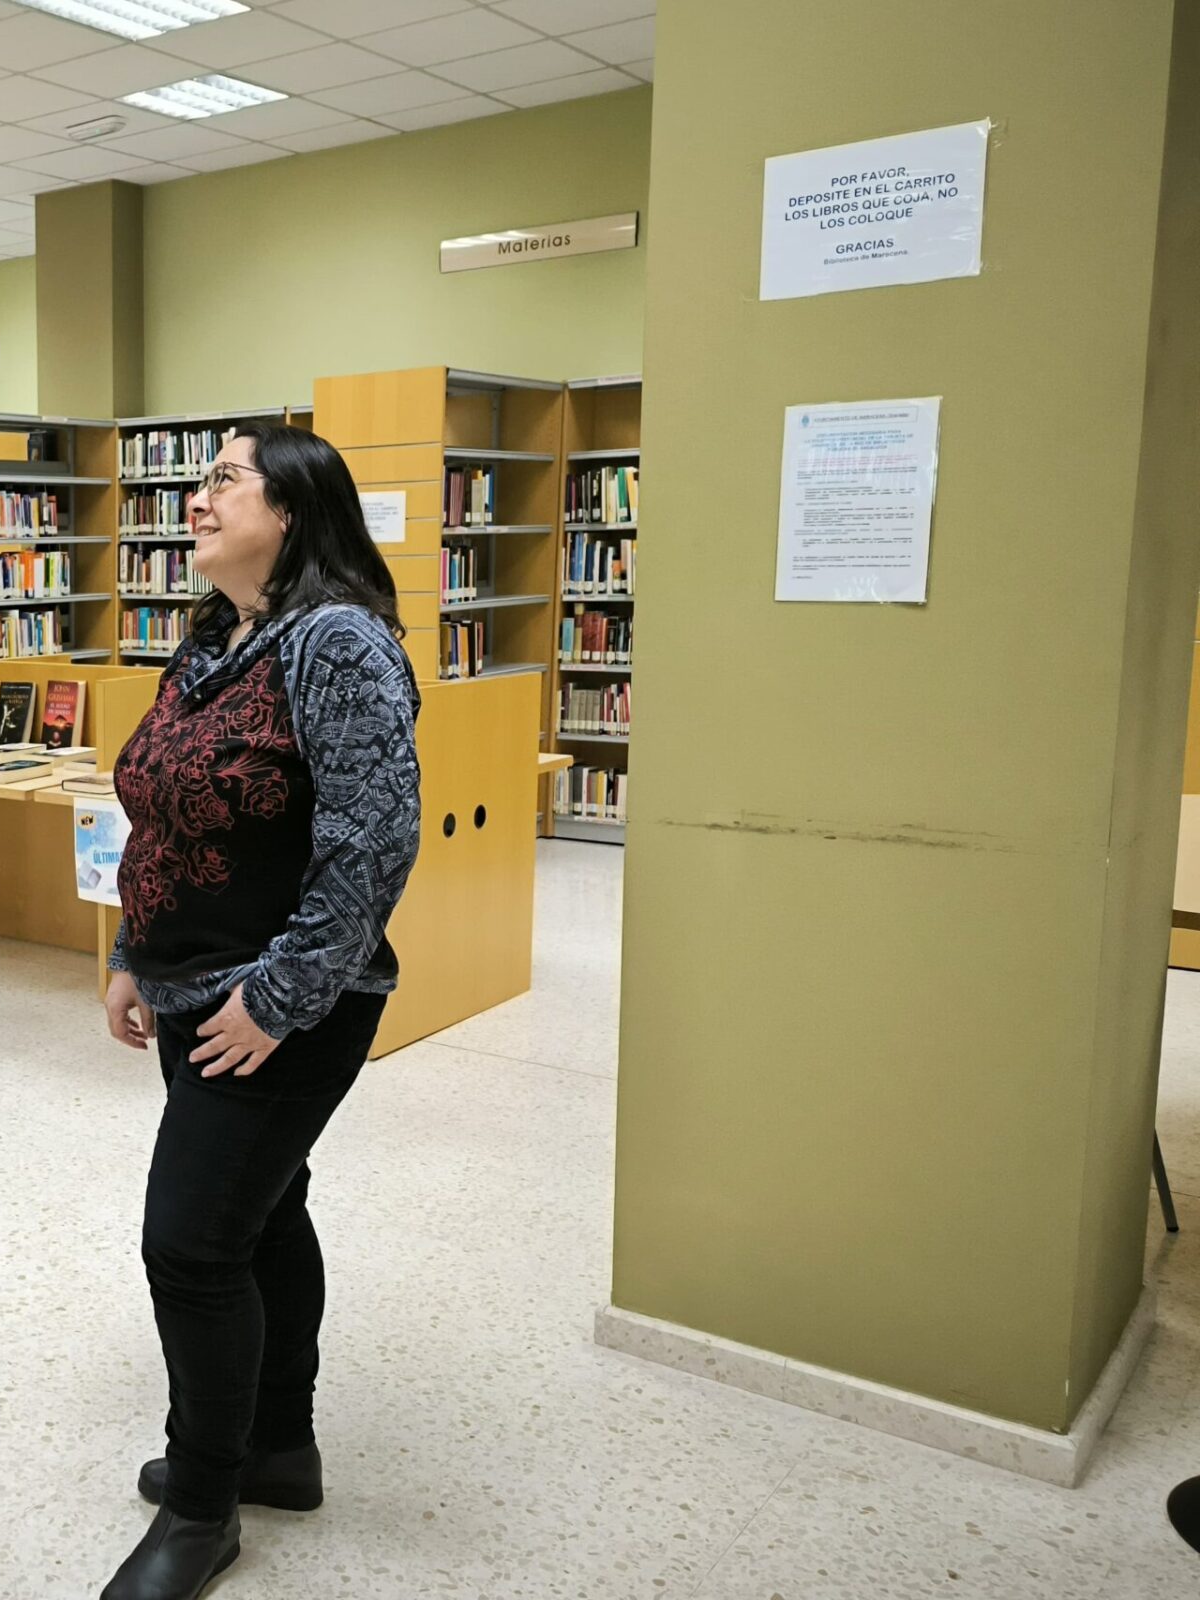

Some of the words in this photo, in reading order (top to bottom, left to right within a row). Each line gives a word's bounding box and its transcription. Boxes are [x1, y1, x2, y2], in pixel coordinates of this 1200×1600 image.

[831, 174, 858, 187] POR
[788, 189, 850, 208] DEPOSITE
[854, 186, 872, 198] EN
[875, 183, 891, 194] EL
[894, 173, 956, 192] CARRITO
[784, 209, 809, 222] LOS
[812, 201, 859, 218] LIBROS
[862, 196, 890, 210] QUE
[937, 187, 958, 199] NO
[820, 217, 845, 230] LOS
[848, 207, 913, 226] COLOQUE
[497, 234, 571, 255] Materias
[835, 238, 894, 255] GRACIAS
[81, 815, 94, 826] NEW
[93, 849, 123, 865] ÚLTIMA
